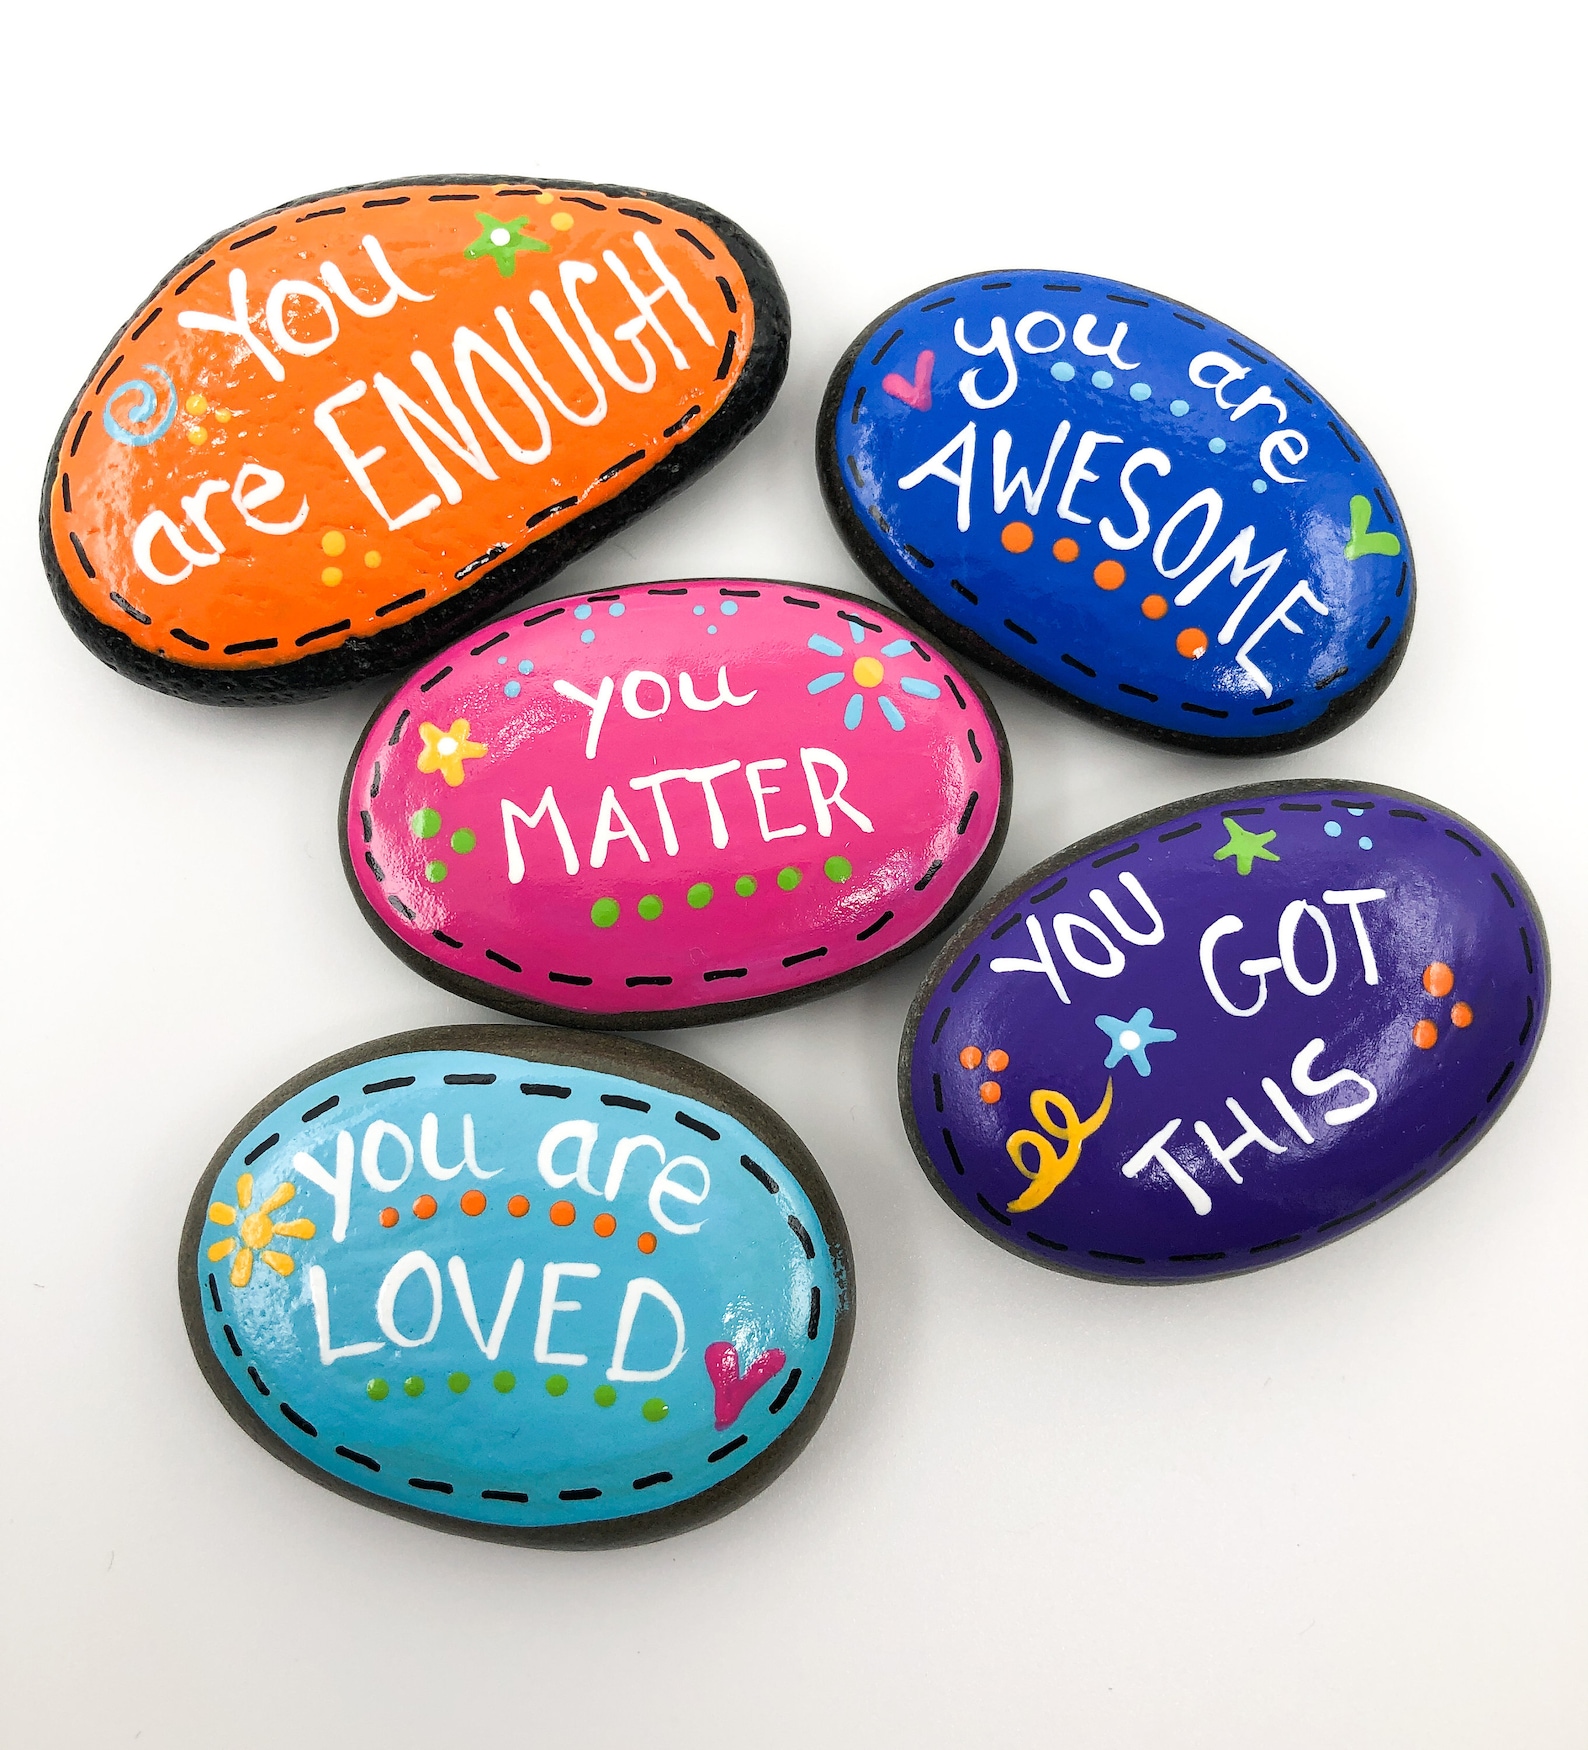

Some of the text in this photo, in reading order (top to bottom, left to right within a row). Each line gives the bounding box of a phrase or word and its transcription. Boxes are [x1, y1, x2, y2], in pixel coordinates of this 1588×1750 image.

[177, 234, 434, 379] You
[132, 230, 715, 585] are ENOUGH
[955, 311, 1312, 484] you are
[898, 419, 1331, 698] AWESOME
[552, 665, 758, 757] you
[500, 747, 875, 884] MATTER
[989, 871, 1387, 1017] YOU GOT
[292, 1112, 711, 1241] you are
[1121, 1036, 1375, 1216] THIS
[304, 1250, 686, 1382] LOVED
